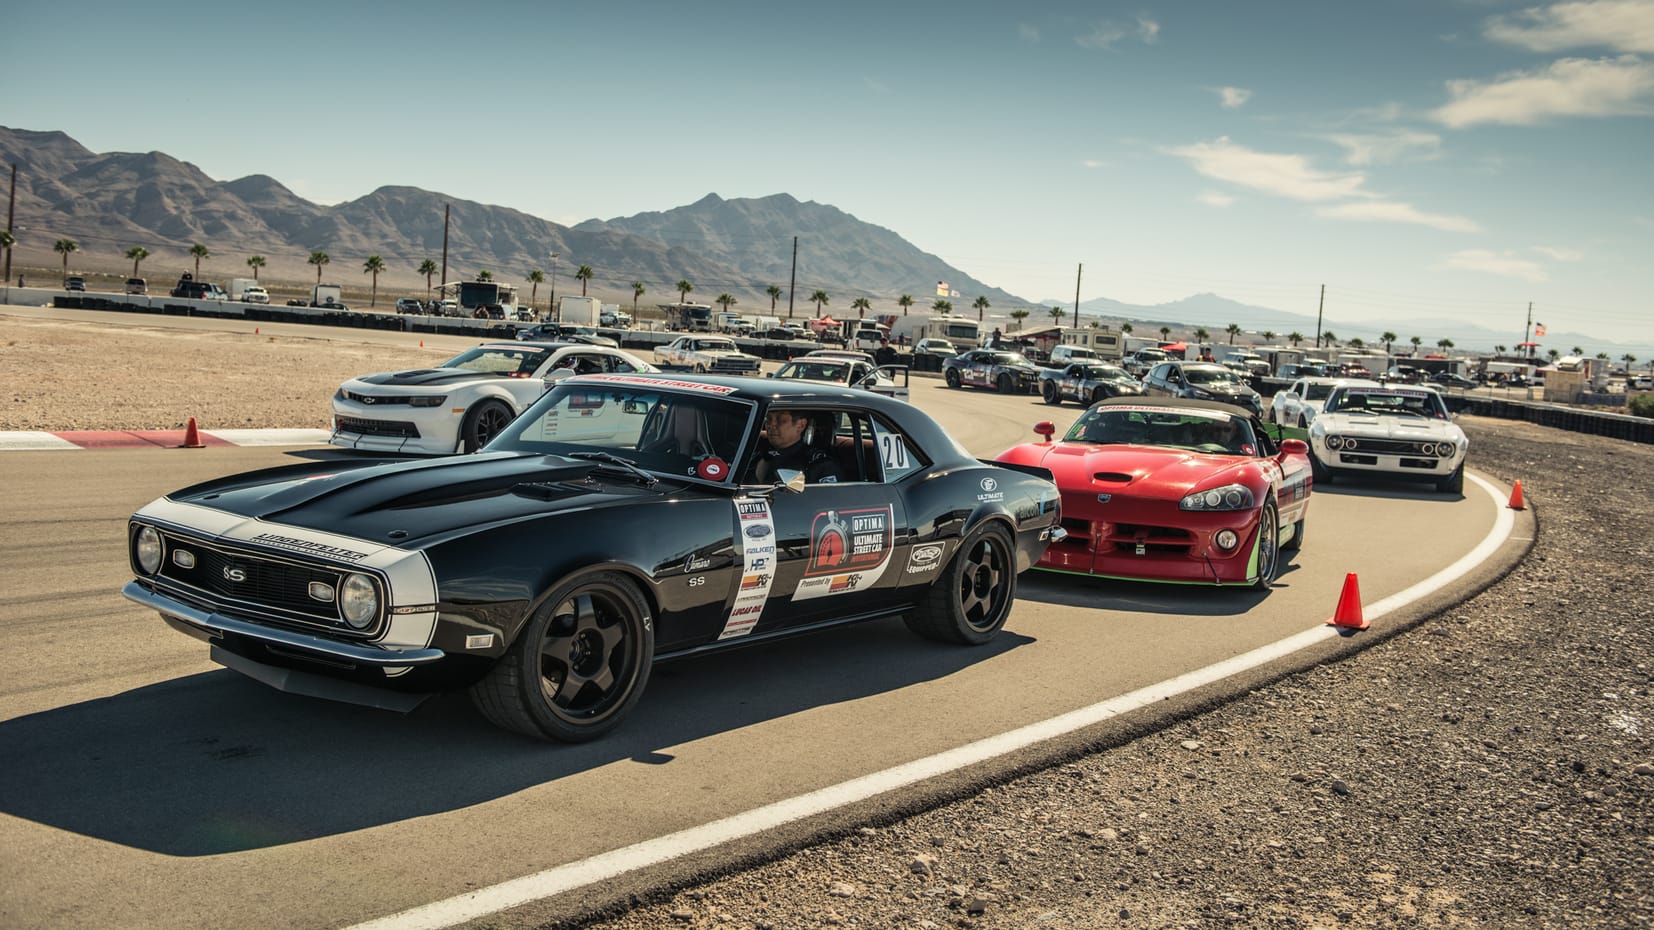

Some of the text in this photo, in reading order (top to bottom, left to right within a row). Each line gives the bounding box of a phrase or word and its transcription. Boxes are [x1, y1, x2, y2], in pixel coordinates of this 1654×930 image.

[883, 436, 905, 468] 20
[740, 503, 766, 513] OPTIMA
[854, 517, 883, 531] OPTIMA
[854, 534, 883, 545] ULTIMATE
[258, 533, 369, 559] LINGENFELTER
[746, 546, 775, 554] FALKEN
[853, 543, 883, 555] STREET CAR
[224, 567, 245, 581] SS
[908, 562, 937, 574] EQUIPPED
[689, 576, 705, 587] SS
[801, 578, 824, 588] Presented
